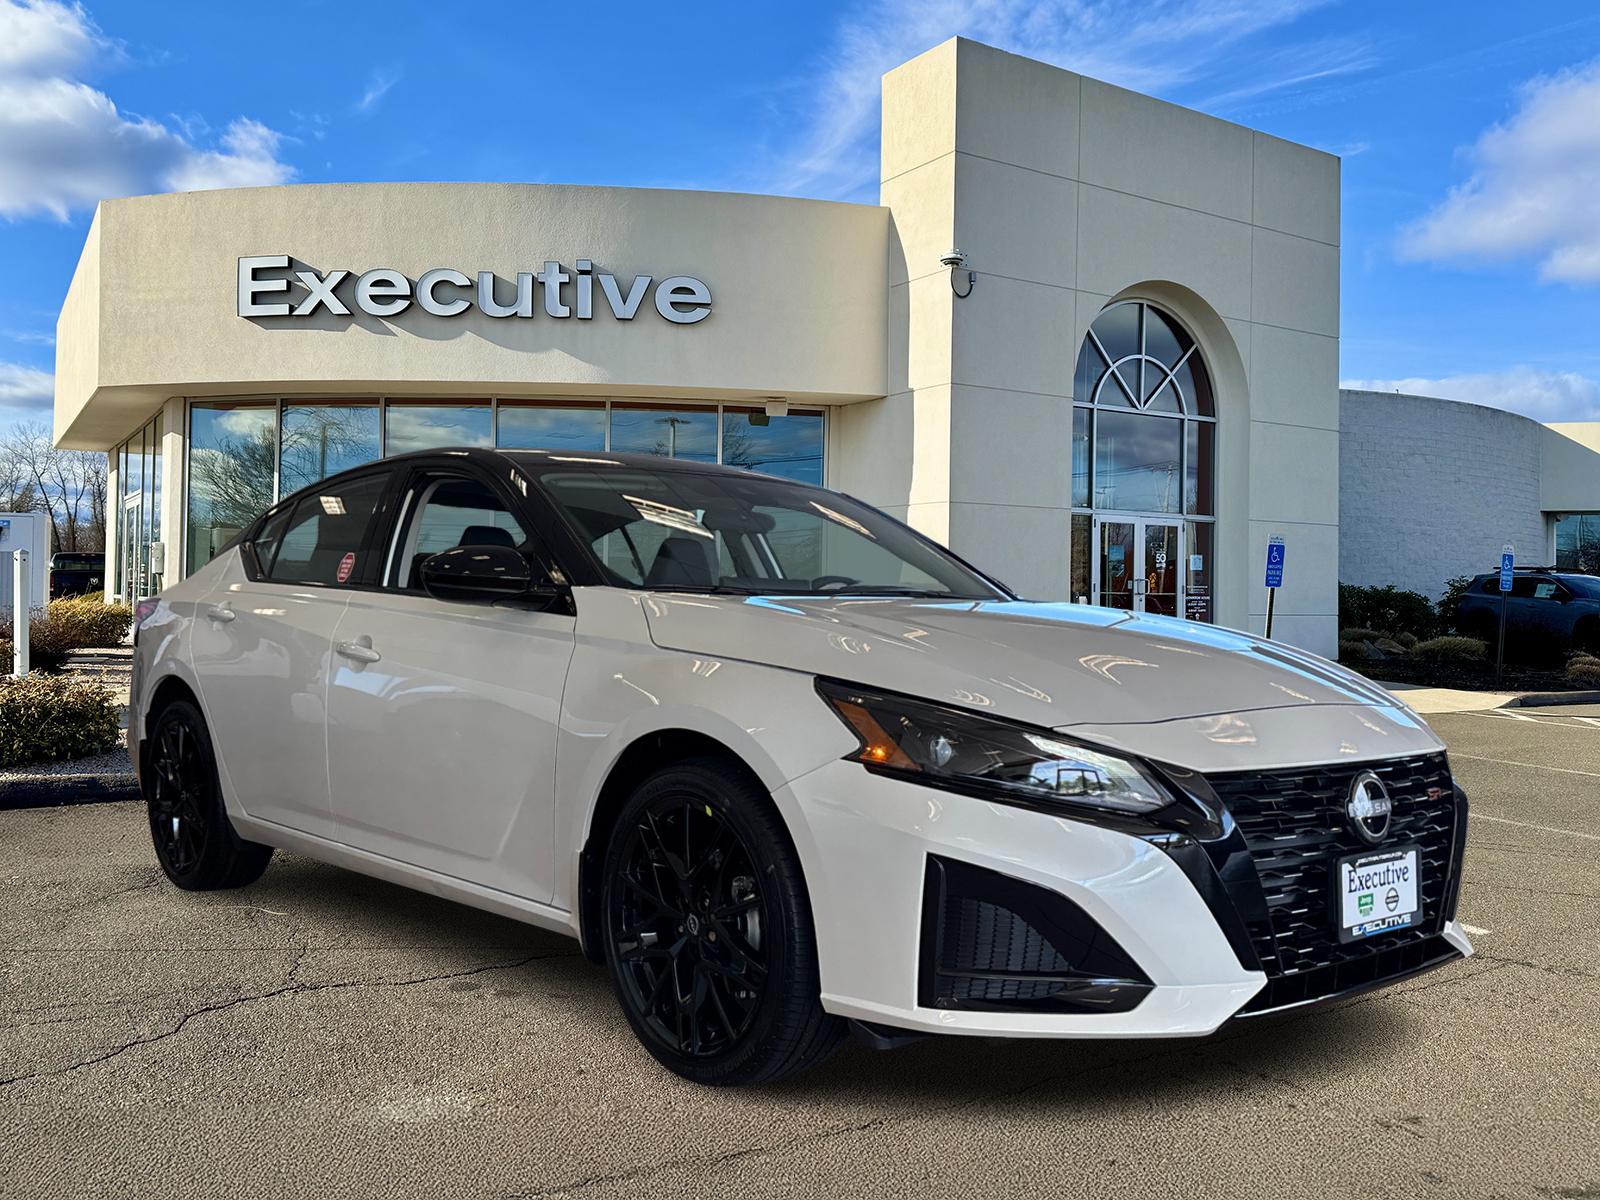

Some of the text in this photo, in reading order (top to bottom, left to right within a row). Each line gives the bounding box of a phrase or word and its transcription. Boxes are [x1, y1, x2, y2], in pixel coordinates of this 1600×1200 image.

[237, 255, 713, 325] Executive
[1348, 863, 1409, 893] Executive
[1352, 914, 1411, 936] EXECUTIVE
